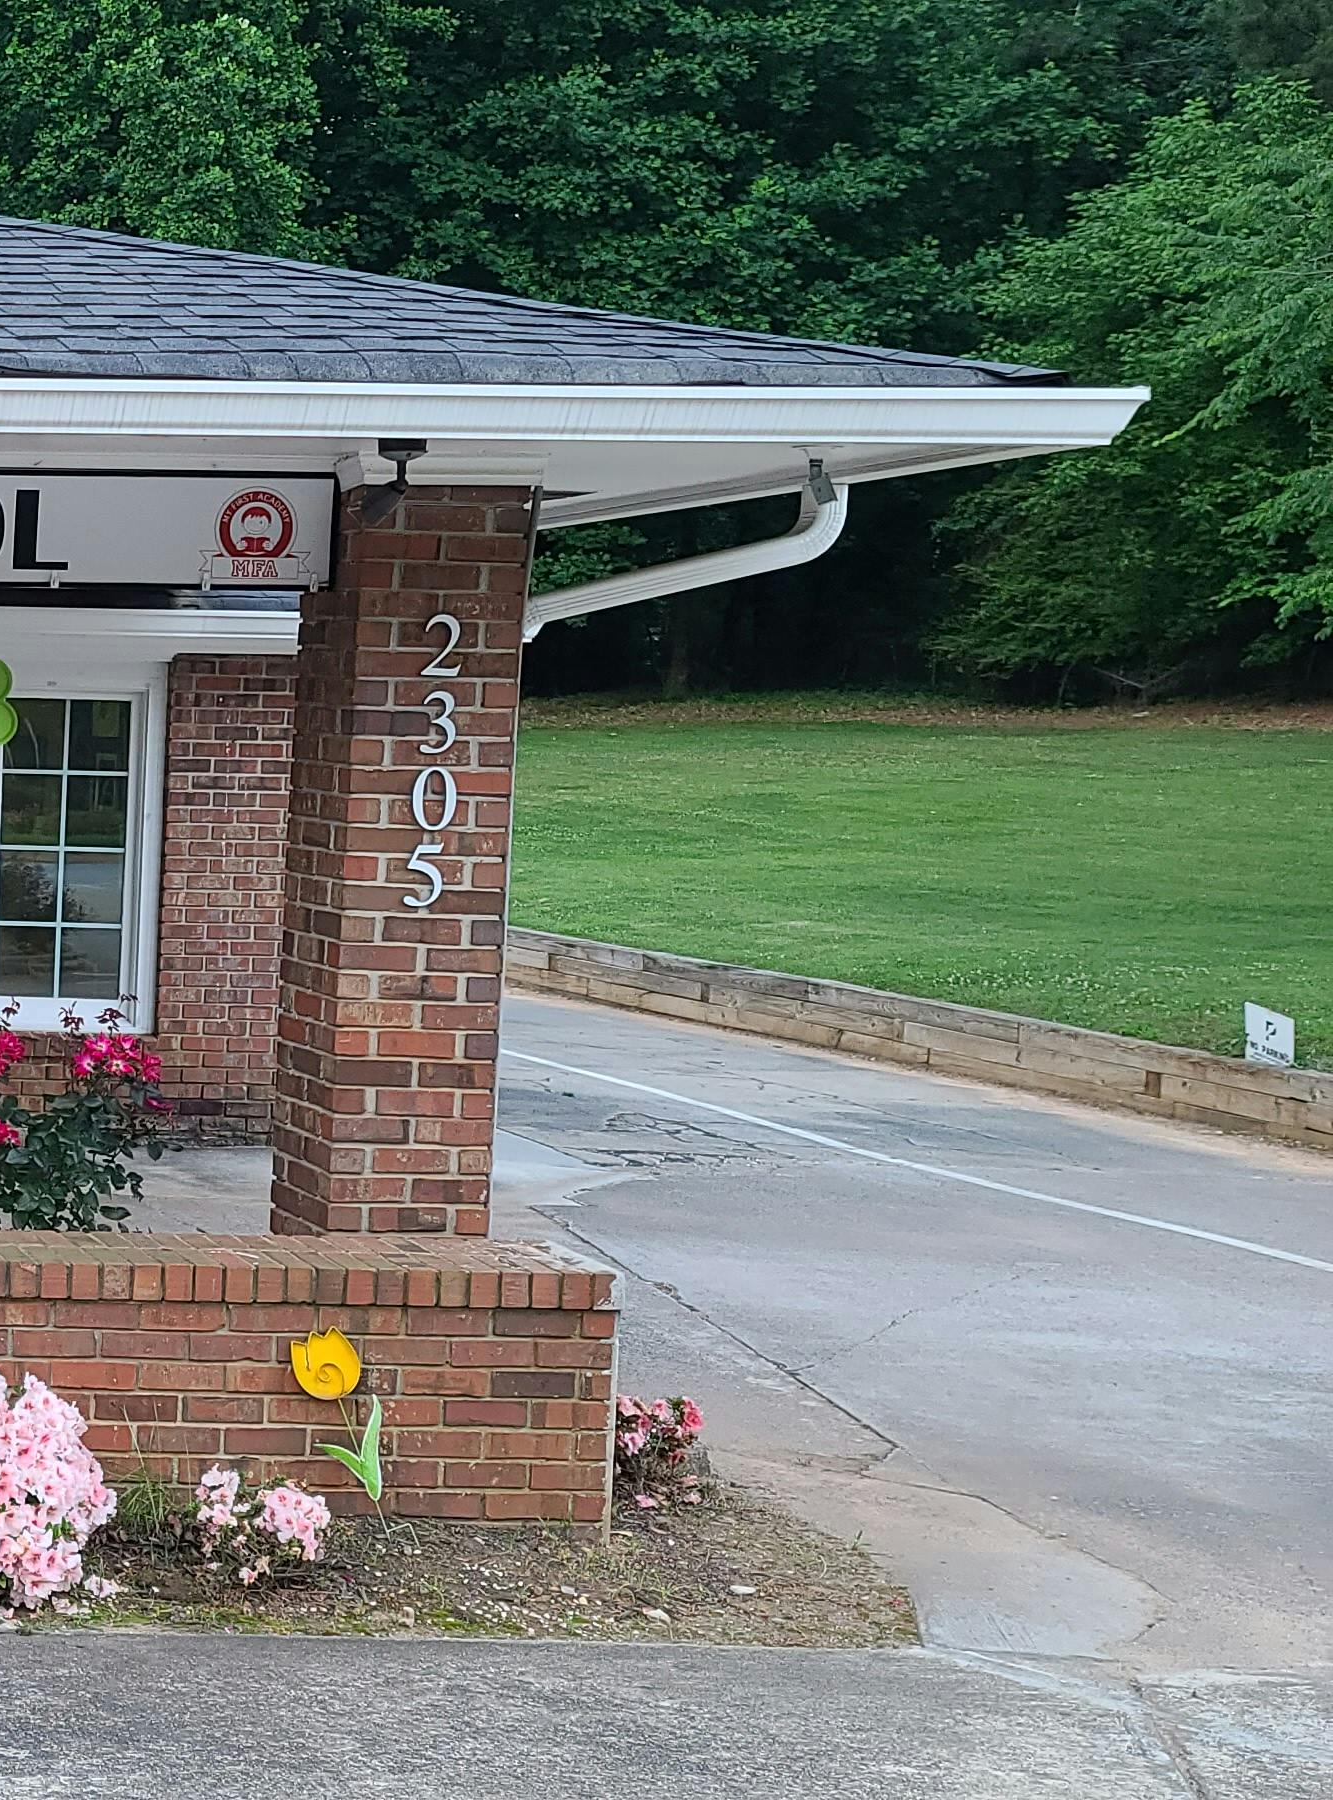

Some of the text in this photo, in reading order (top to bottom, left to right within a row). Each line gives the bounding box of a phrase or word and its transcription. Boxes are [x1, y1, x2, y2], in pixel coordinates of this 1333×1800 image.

[222, 493, 291, 523] MY FIRST ACADEMY
[232, 559, 278, 577] MFA
